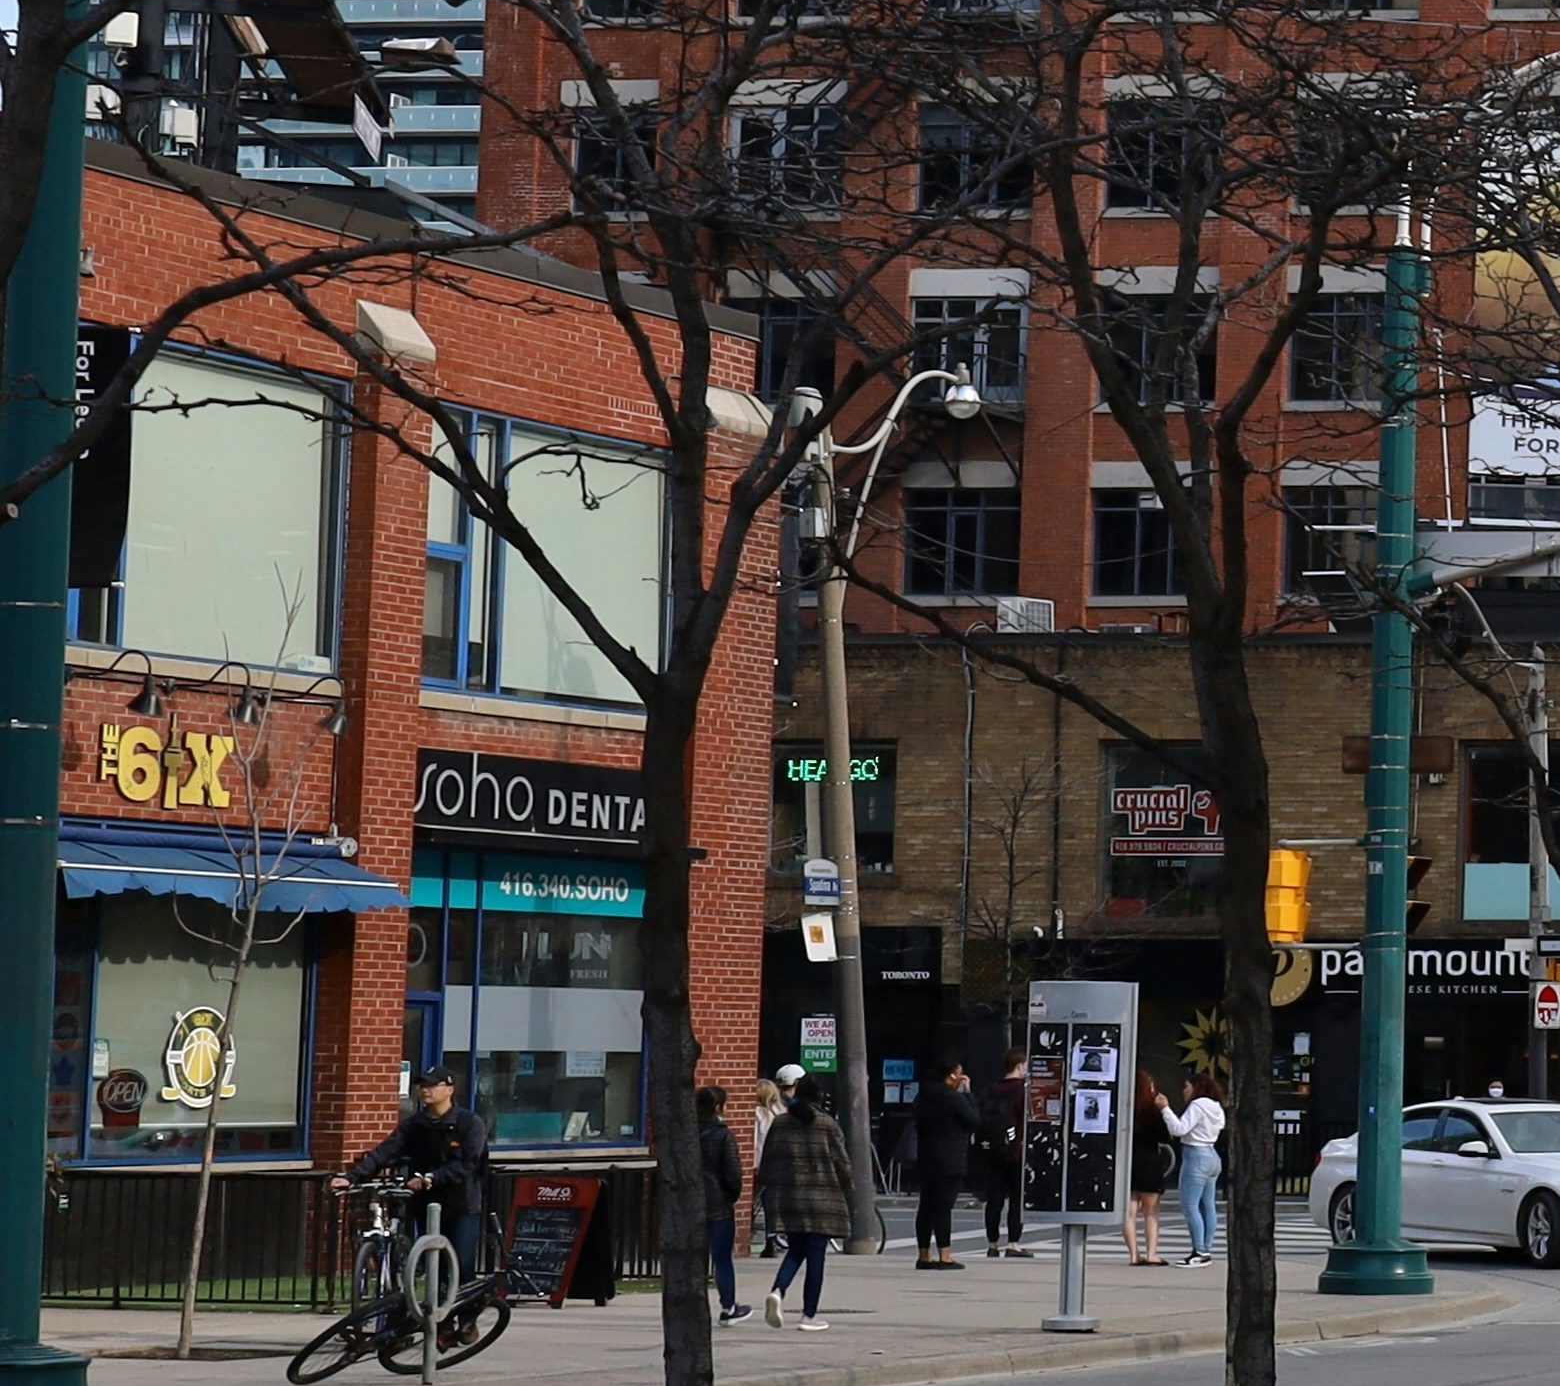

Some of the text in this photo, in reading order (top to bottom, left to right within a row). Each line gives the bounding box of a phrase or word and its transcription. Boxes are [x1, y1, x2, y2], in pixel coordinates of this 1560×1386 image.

[74, 340, 95, 382] For
[1514, 438, 1559, 454] FOR
[101, 723, 120, 781] THE
[413, 752, 646, 832] soho DENTA
[1116, 788, 1185, 810] crucial
[1133, 810, 1179, 830] pins
[499, 871, 629, 903] 416.340.SOHO
[881, 971, 930, 980] TORONTO
[1438, 984, 1498, 995] KITCHEN
[804, 1020, 819, 1029] WE
[807, 1029, 834, 1038] OPEN
[106, 1081, 144, 1102] OPEN
